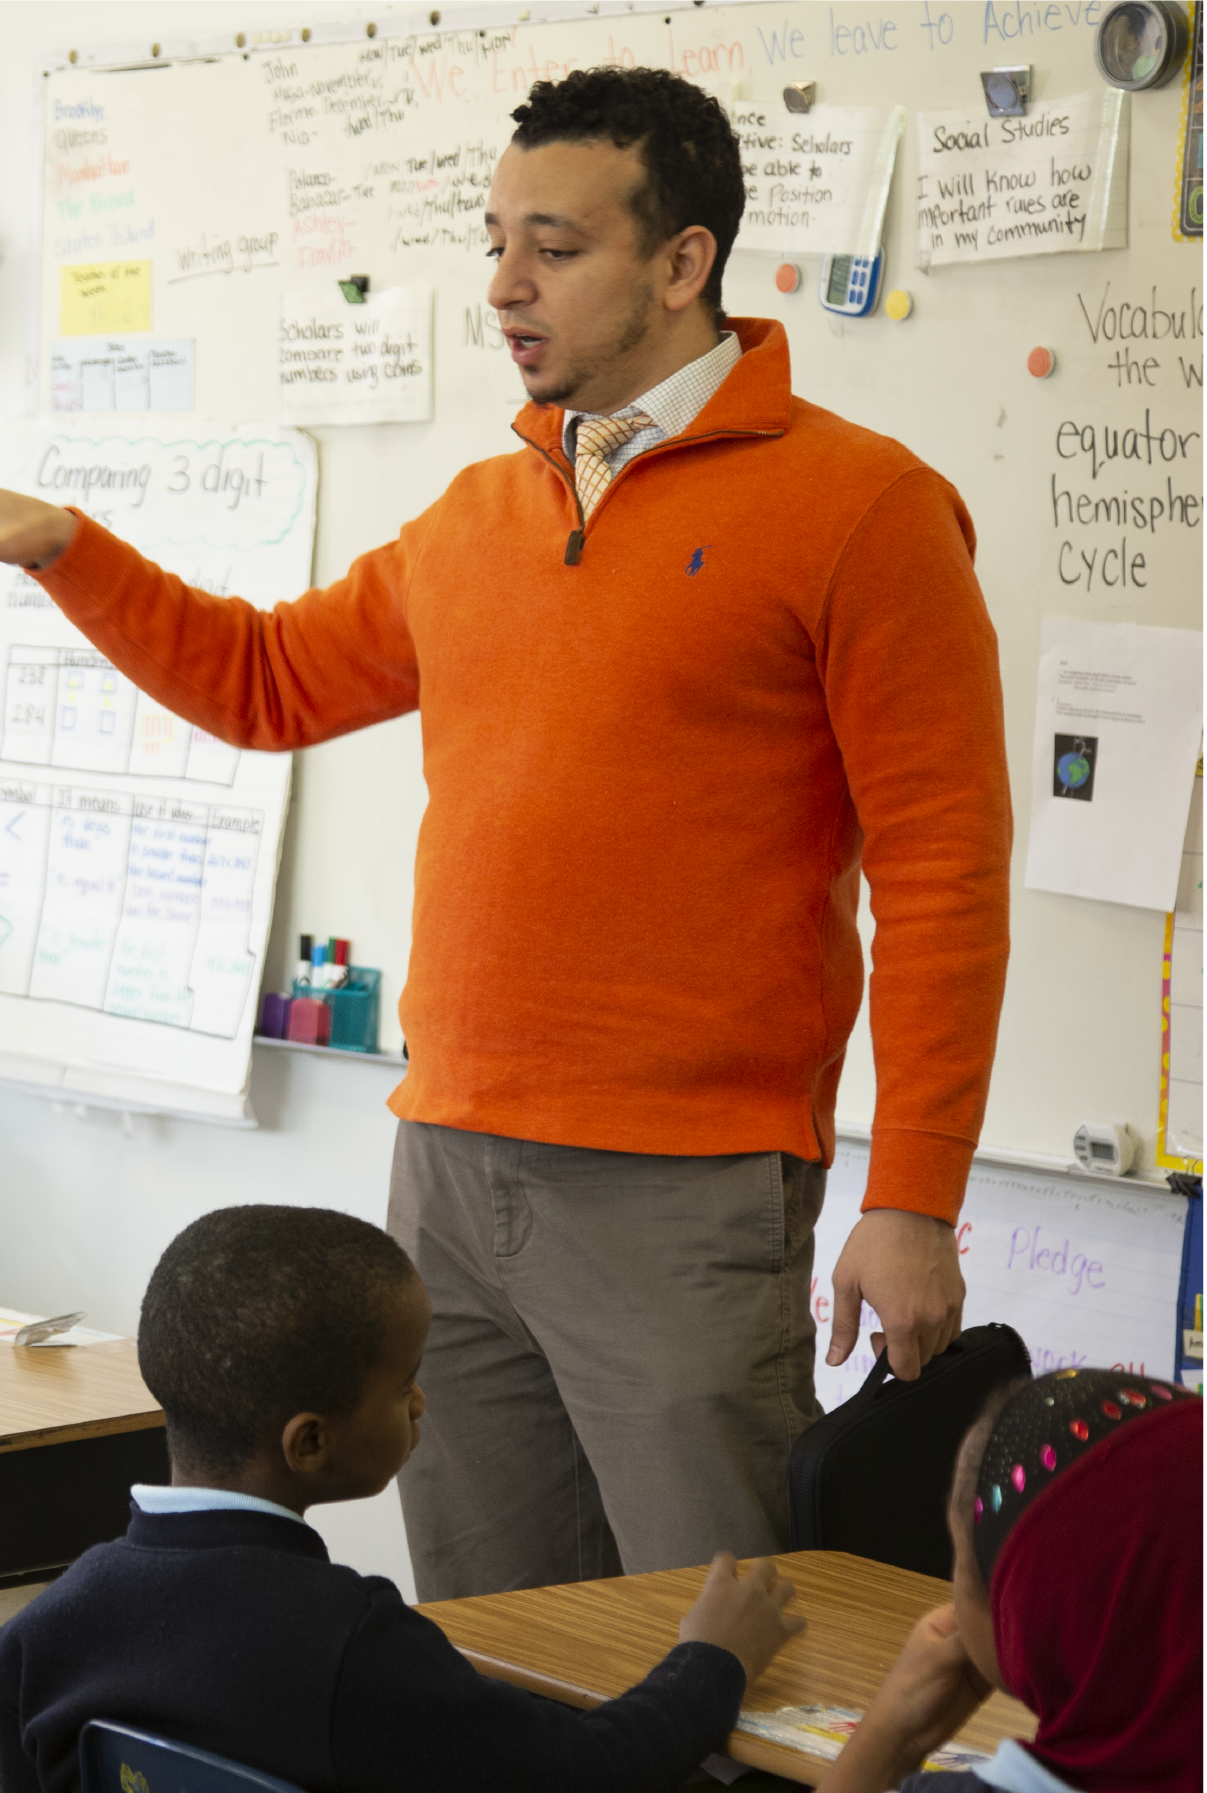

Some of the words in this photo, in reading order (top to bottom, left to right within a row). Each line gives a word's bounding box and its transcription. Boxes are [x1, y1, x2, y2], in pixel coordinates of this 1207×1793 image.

[757, 18, 805, 66] We
[830, 7, 899, 57] leave
[920, 0, 954, 50] to
[413, 56, 467, 102] We
[792, 132, 854, 155] Scholars
[933, 121, 989, 153] Social
[1002, 111, 1070, 142] Studies
[764, 159, 802, 177] able
[809, 160, 822, 181] to
[917, 175, 929, 200] I
[1051, 156, 1092, 186] how
[1052, 190, 1080, 209] are
[955, 227, 979, 250] my
[987, 213, 1087, 245] community
[279, 316, 344, 341] Scholars
[355, 317, 380, 336] will
[381, 333, 418, 362] digit
[1108, 347, 1161, 387] the
[1056, 408, 1200, 479] equator
[37, 444, 152, 508] Comparing
[168, 455, 192, 493] 3
[202, 447, 267, 511] digit
[1051, 474, 1204, 533] hemisphe
[1007, 1225, 1106, 1296] Pledge
